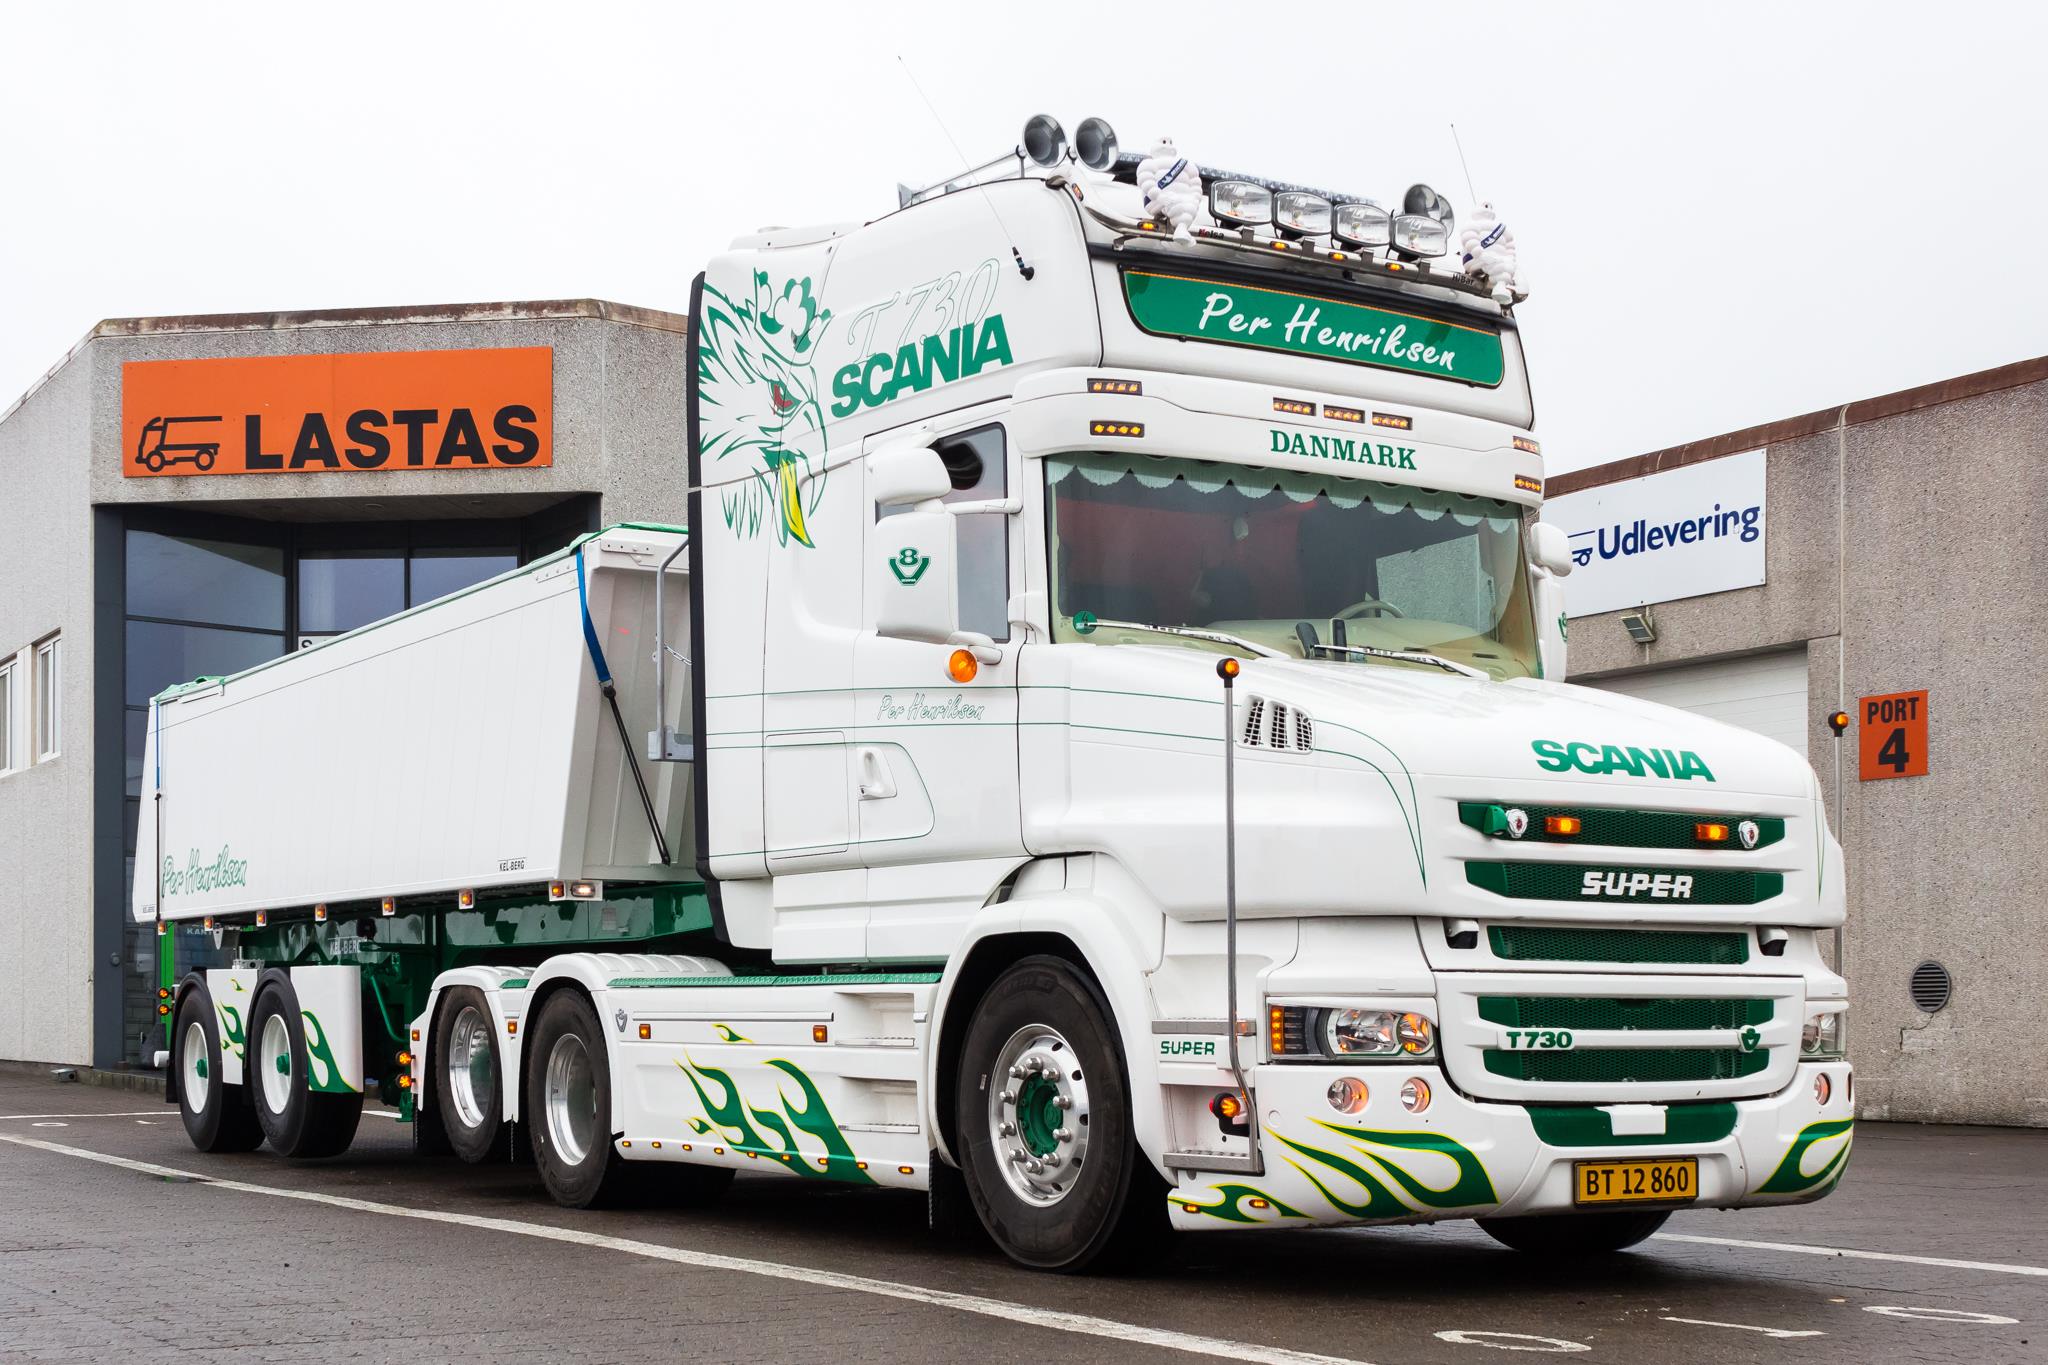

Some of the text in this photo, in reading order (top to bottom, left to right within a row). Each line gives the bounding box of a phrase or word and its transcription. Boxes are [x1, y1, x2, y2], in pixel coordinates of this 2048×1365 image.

[1198, 292, 1456, 371] Per Henriksen
[831, 313, 1014, 418] SCANIA
[245, 404, 540, 470] LASTAS
[1270, 430, 1417, 470] DANMARK
[1598, 503, 1761, 560] Udlevering
[877, 692, 985, 720] Per Henriksen
[1867, 696, 1920, 725] PORT
[1531, 739, 1717, 783] SCANIA
[1878, 727, 1910, 773] 4
[161, 844, 247, 899] Per Henriksen
[1580, 871, 1693, 899] SUPER
[1160, 1040, 1215, 1056] SUPER
[1586, 1166, 1689, 1196] BT 12 860
